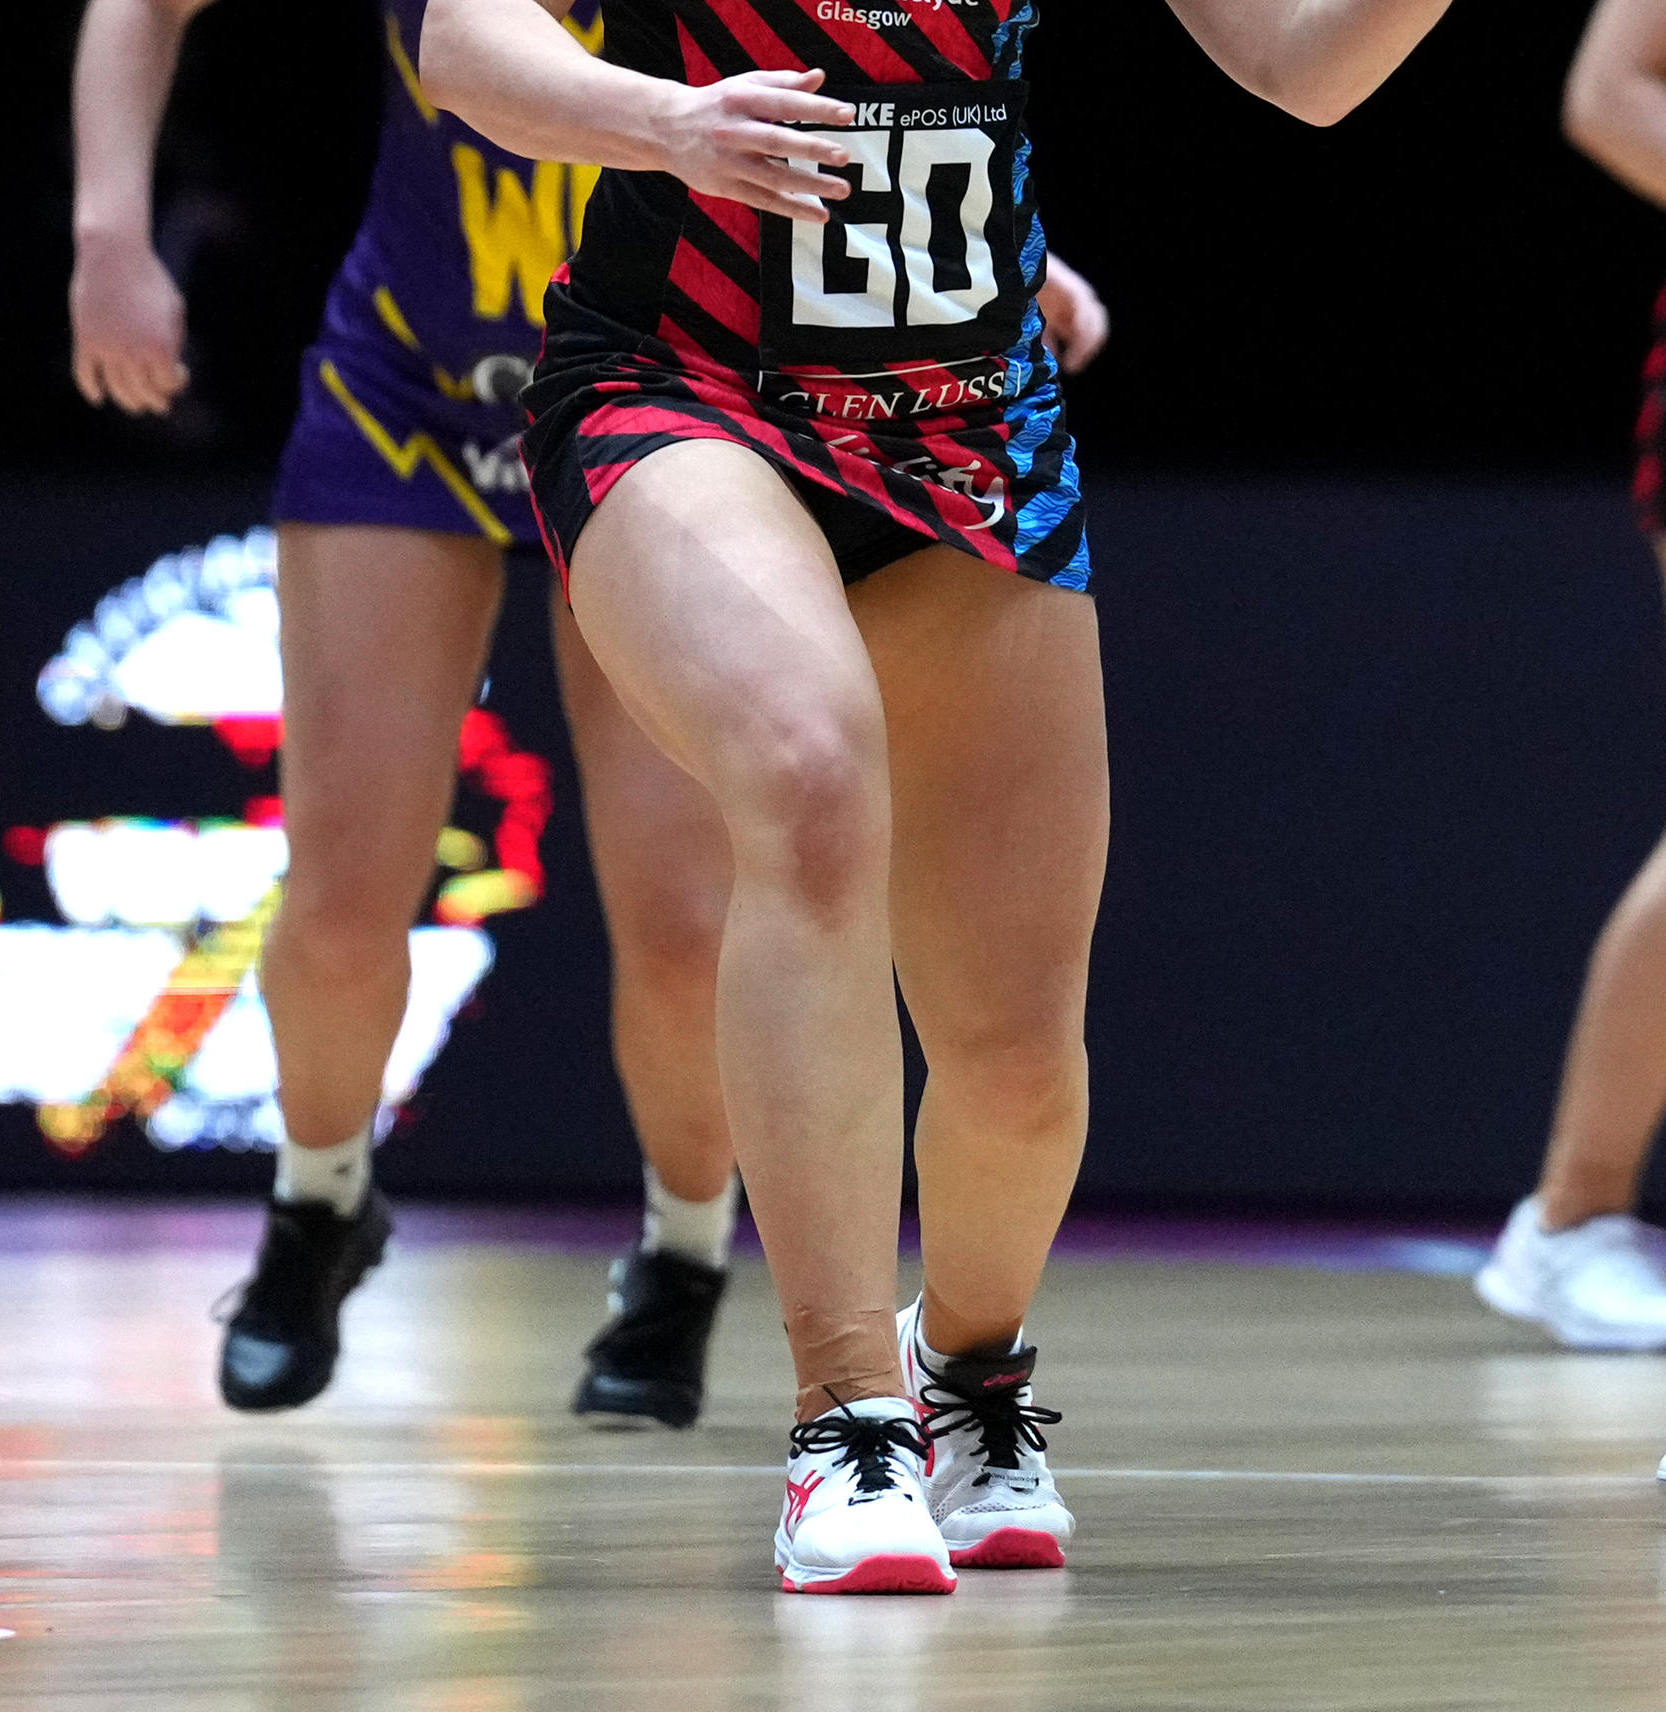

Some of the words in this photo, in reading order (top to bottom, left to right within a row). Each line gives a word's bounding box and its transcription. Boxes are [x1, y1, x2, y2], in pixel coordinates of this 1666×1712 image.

[816, 0, 912, 30] Glasgow
[900, 108, 947, 126] ePOS
[952, 104, 982, 126] (UK)
[984, 103, 1008, 122] Ltd
[451, 143, 603, 329] W
[909, 371, 1005, 414] LUSS
